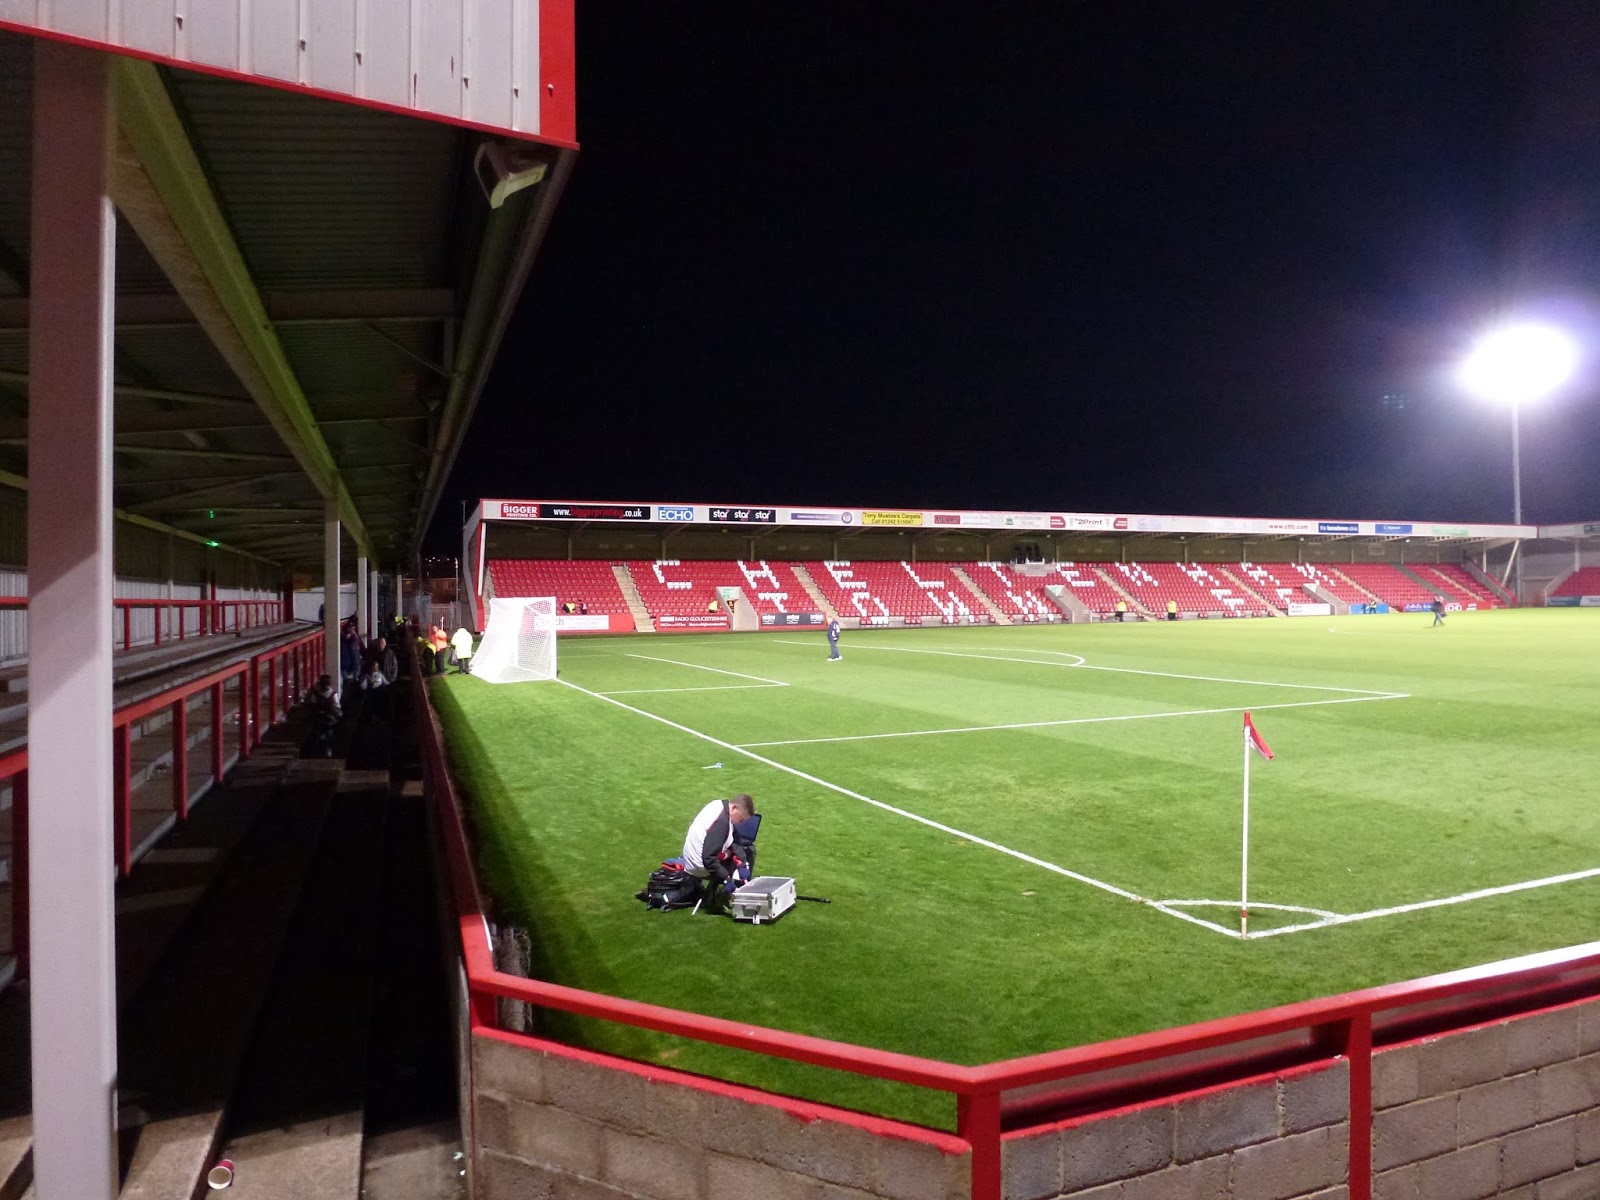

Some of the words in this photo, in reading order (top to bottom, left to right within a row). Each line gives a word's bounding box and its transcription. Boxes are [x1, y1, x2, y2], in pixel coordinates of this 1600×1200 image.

[503, 506, 537, 514] BIGGER
[659, 510, 693, 520] ECHO
[713, 509, 729, 518] star
[734, 510, 750, 519] star
[755, 511, 771, 519] star
